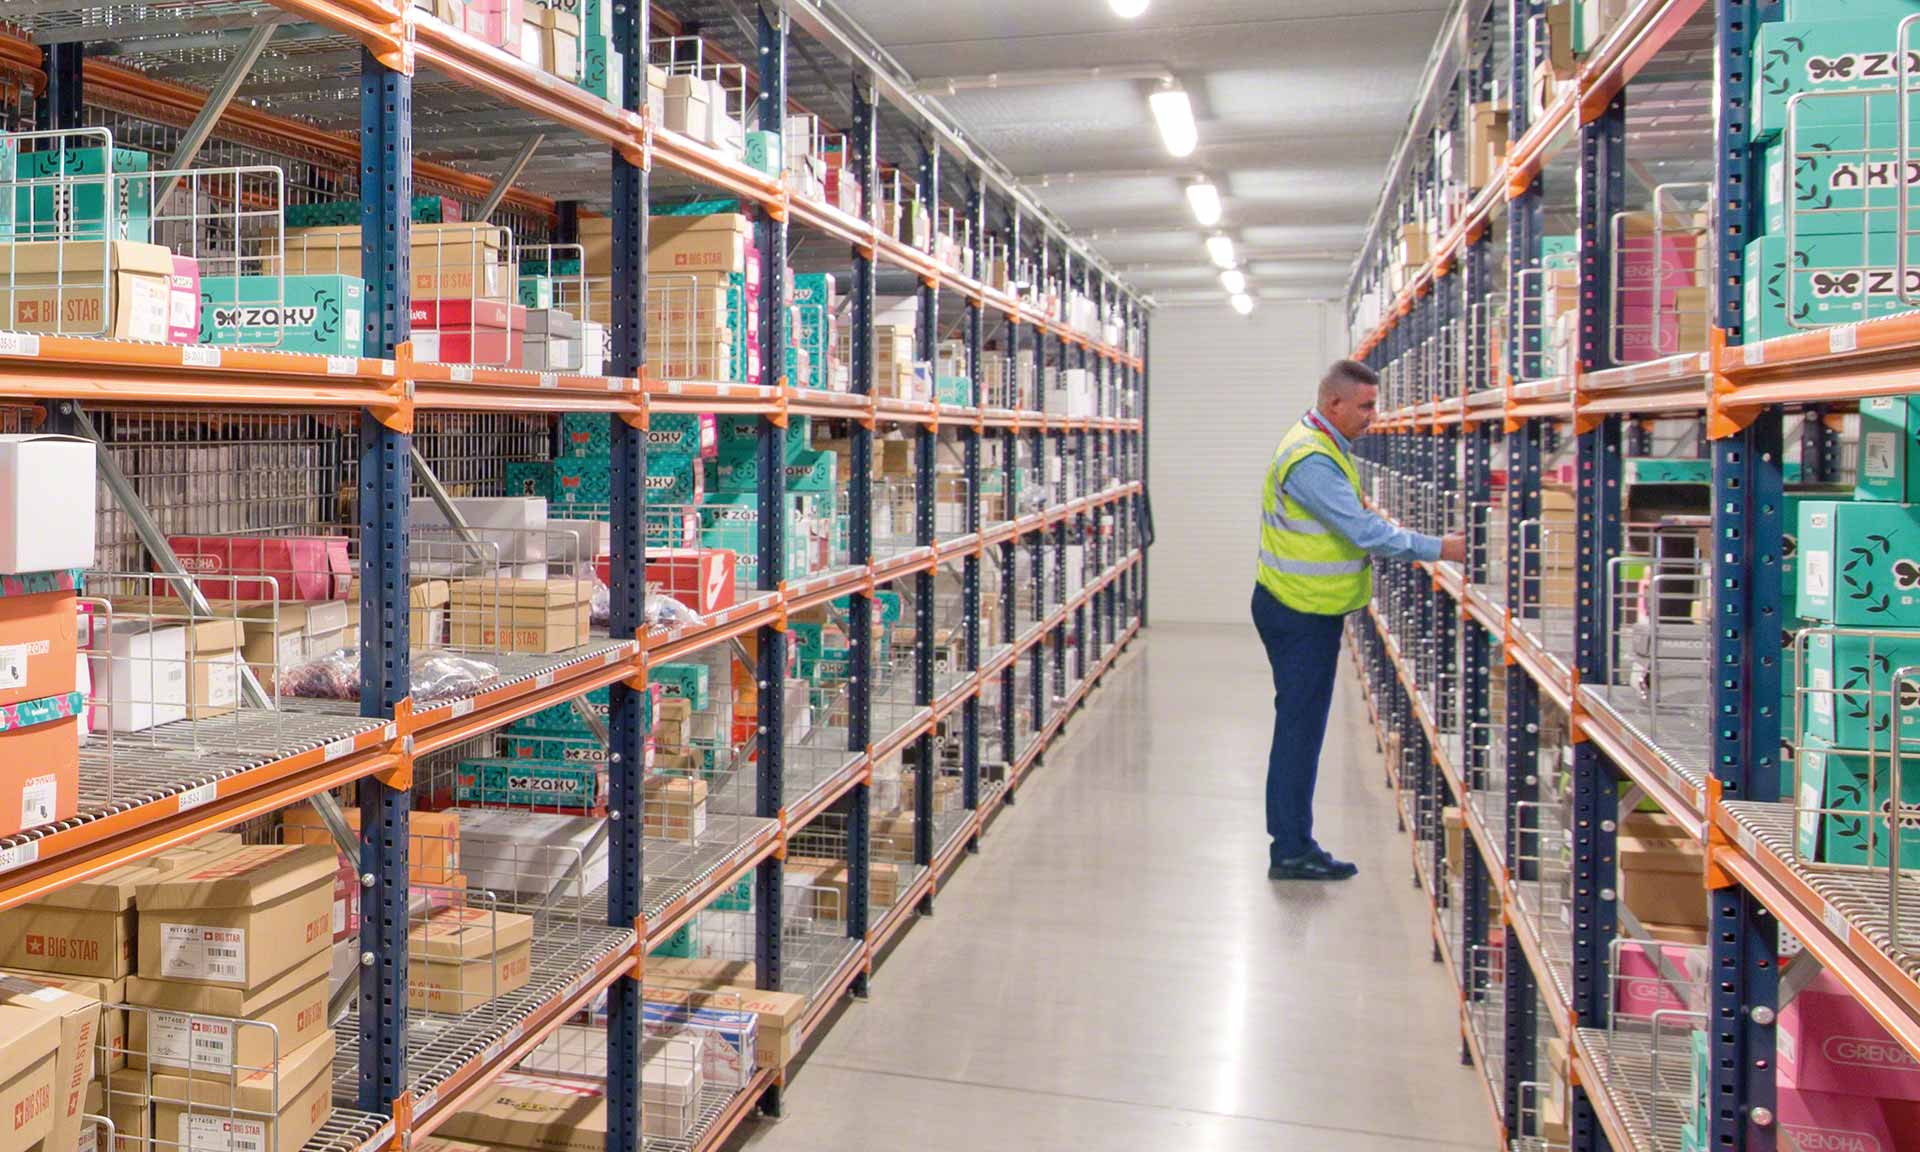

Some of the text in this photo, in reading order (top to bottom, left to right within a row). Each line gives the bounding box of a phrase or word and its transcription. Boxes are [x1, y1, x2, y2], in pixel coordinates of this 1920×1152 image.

[1863, 52, 1920, 76] za
[1832, 162, 1920, 187] axy
[702, 251, 721, 265] STAR
[1868, 270, 1920, 294] za
[67, 298, 99, 322] STAR
[246, 308, 314, 326] zaxy
[648, 431, 682, 442] axy
[785, 466, 813, 476] axy
[645, 478, 674, 488] axy
[732, 510, 758, 520] zax
[516, 631, 538, 647] STAR
[583, 750, 609, 760] zax
[531, 779, 577, 790] zaxy
[214, 931, 241, 943] BIG STAR
[48, 936, 99, 961] BIG STAR
[417, 981, 441, 1001] SAR
[201, 1023, 212, 1034] BIG
[212, 1024, 227, 1036] STAR
[71, 1021, 91, 1089] BIG STAR
[24, 1083, 50, 1124] BIG STAR
[233, 1124, 261, 1136] BIG STAR
[1795, 1130, 1866, 1152] RENDHA
